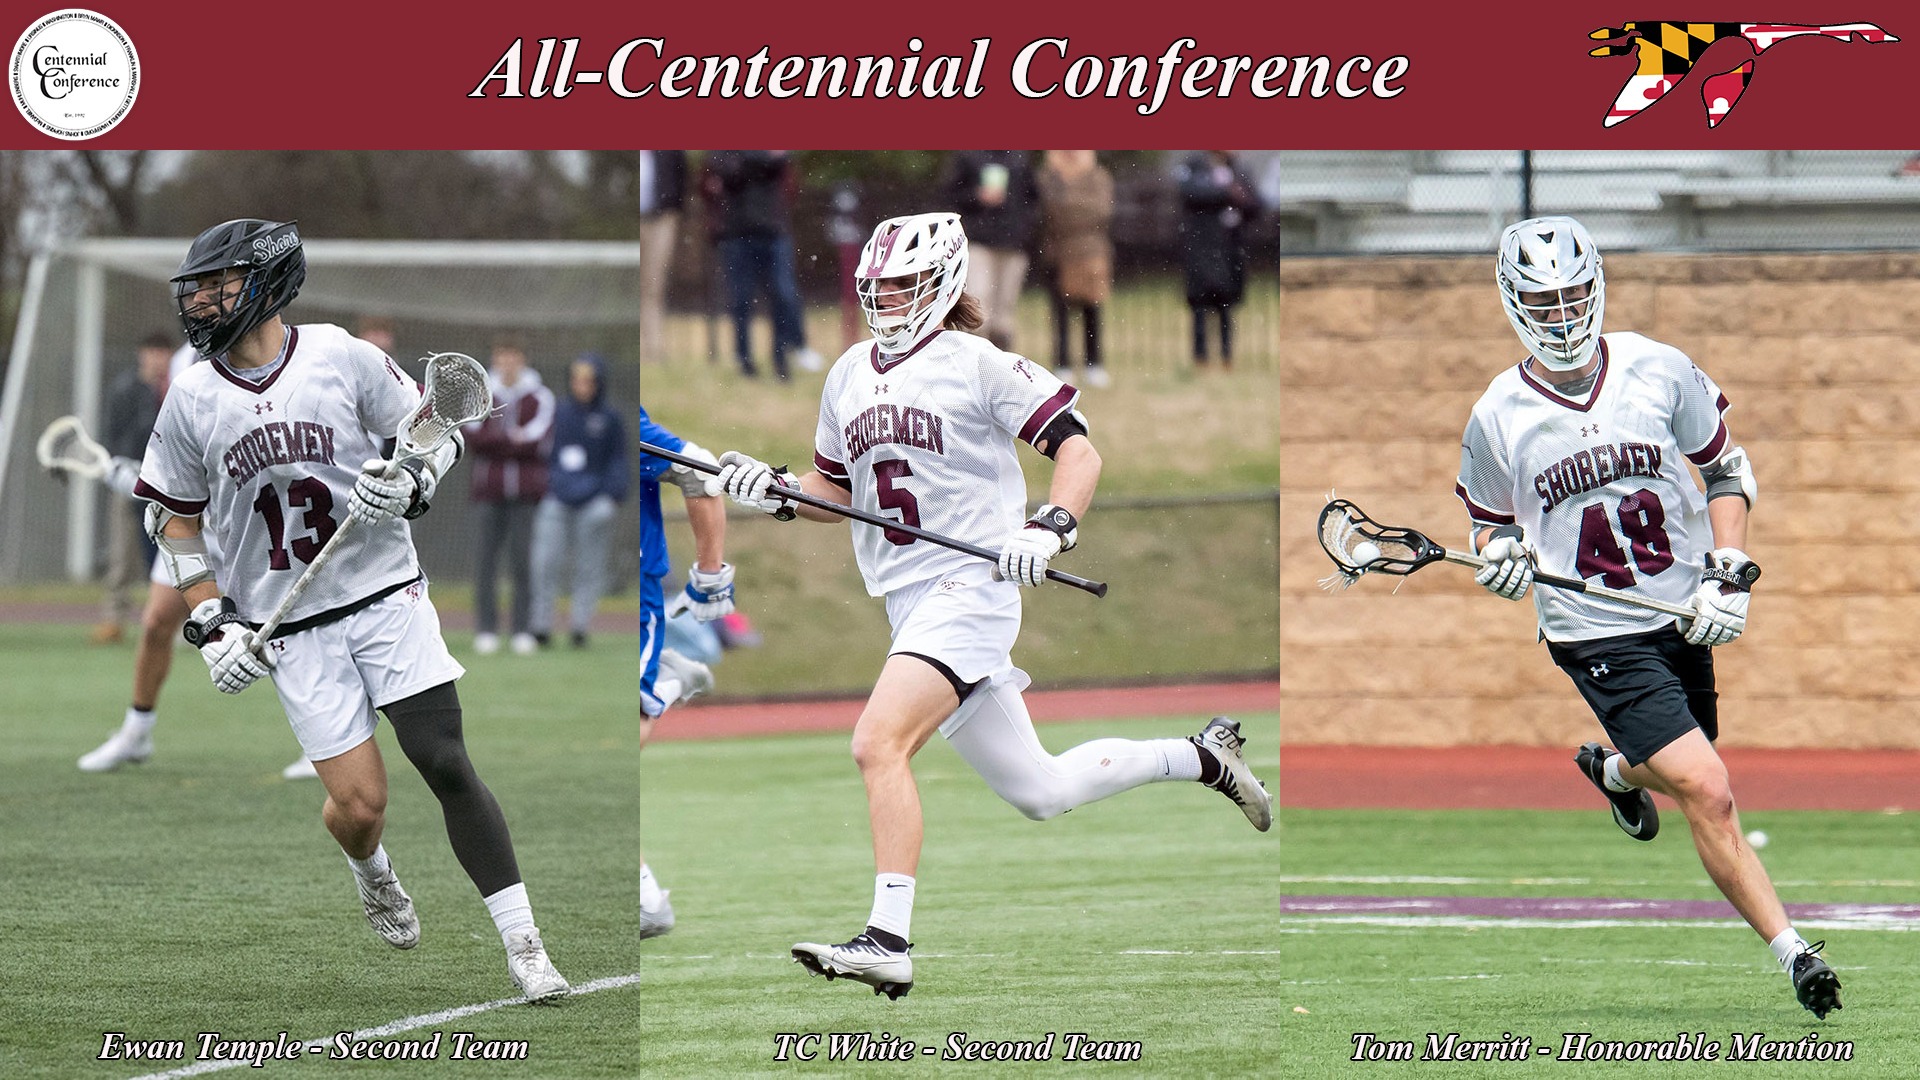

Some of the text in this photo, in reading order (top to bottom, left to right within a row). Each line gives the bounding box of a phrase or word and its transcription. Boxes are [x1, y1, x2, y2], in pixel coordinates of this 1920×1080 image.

[251, 231, 299, 265] Shore
[223, 421, 337, 492] SHOREMEN
[844, 404, 944, 464] SHOREMEN
[872, 458, 921, 546] 5
[1534, 442, 1665, 514] SHOREMEN
[253, 476, 338, 571] 13
[1575, 488, 1675, 590] 48
